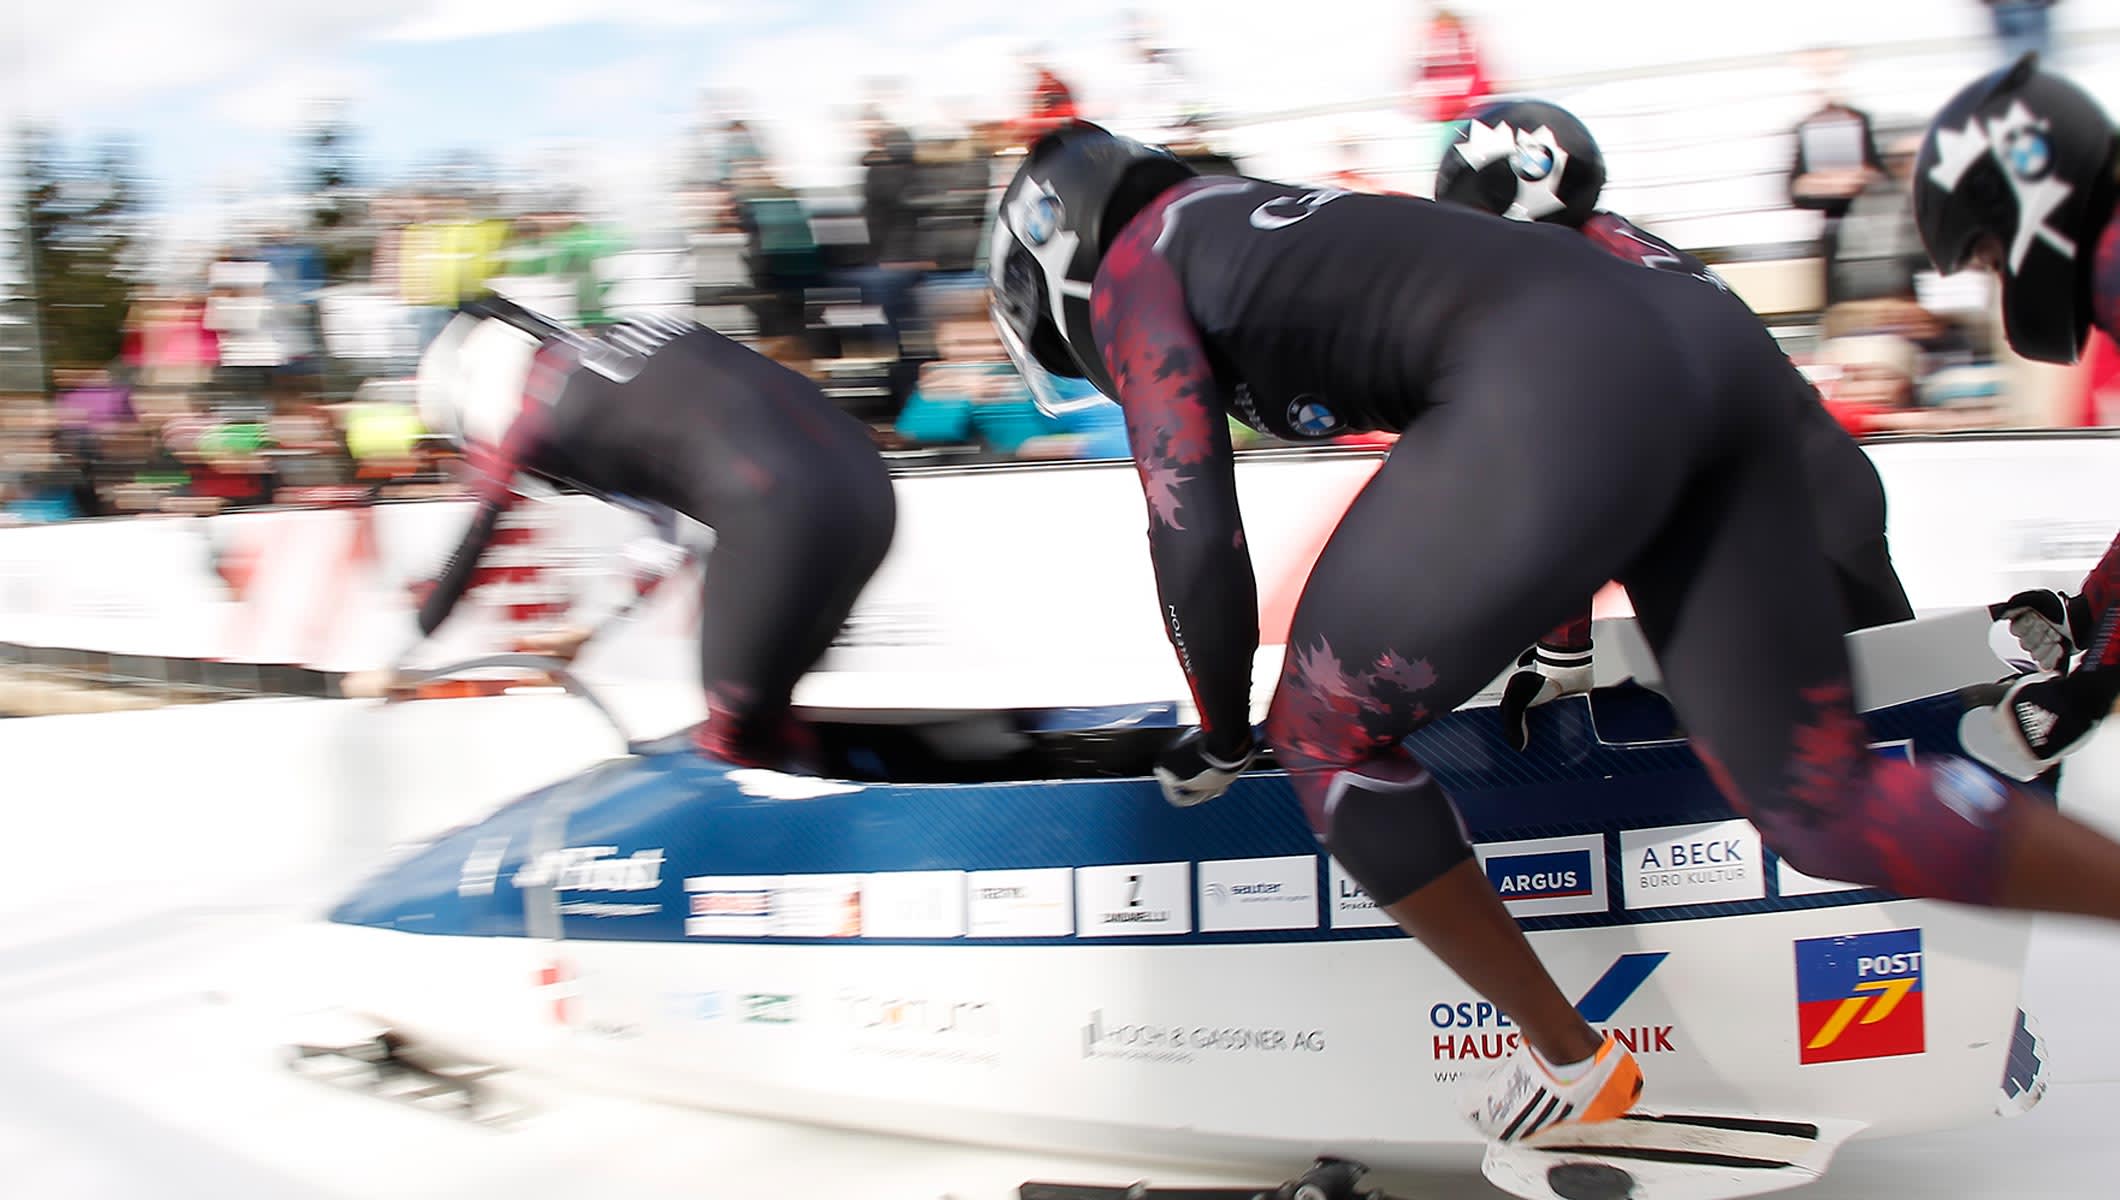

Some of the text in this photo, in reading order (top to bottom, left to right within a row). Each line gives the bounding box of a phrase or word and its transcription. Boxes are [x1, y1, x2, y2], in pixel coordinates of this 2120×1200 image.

[1640, 840, 1742, 869] A BECK
[1500, 871, 1577, 893] ARGUS
[1687, 868, 1745, 885] KULTUR
[1857, 951, 1922, 976] POST
[1191, 1027, 1286, 1050] GASSNER
[1292, 1029, 1326, 1051] AG
